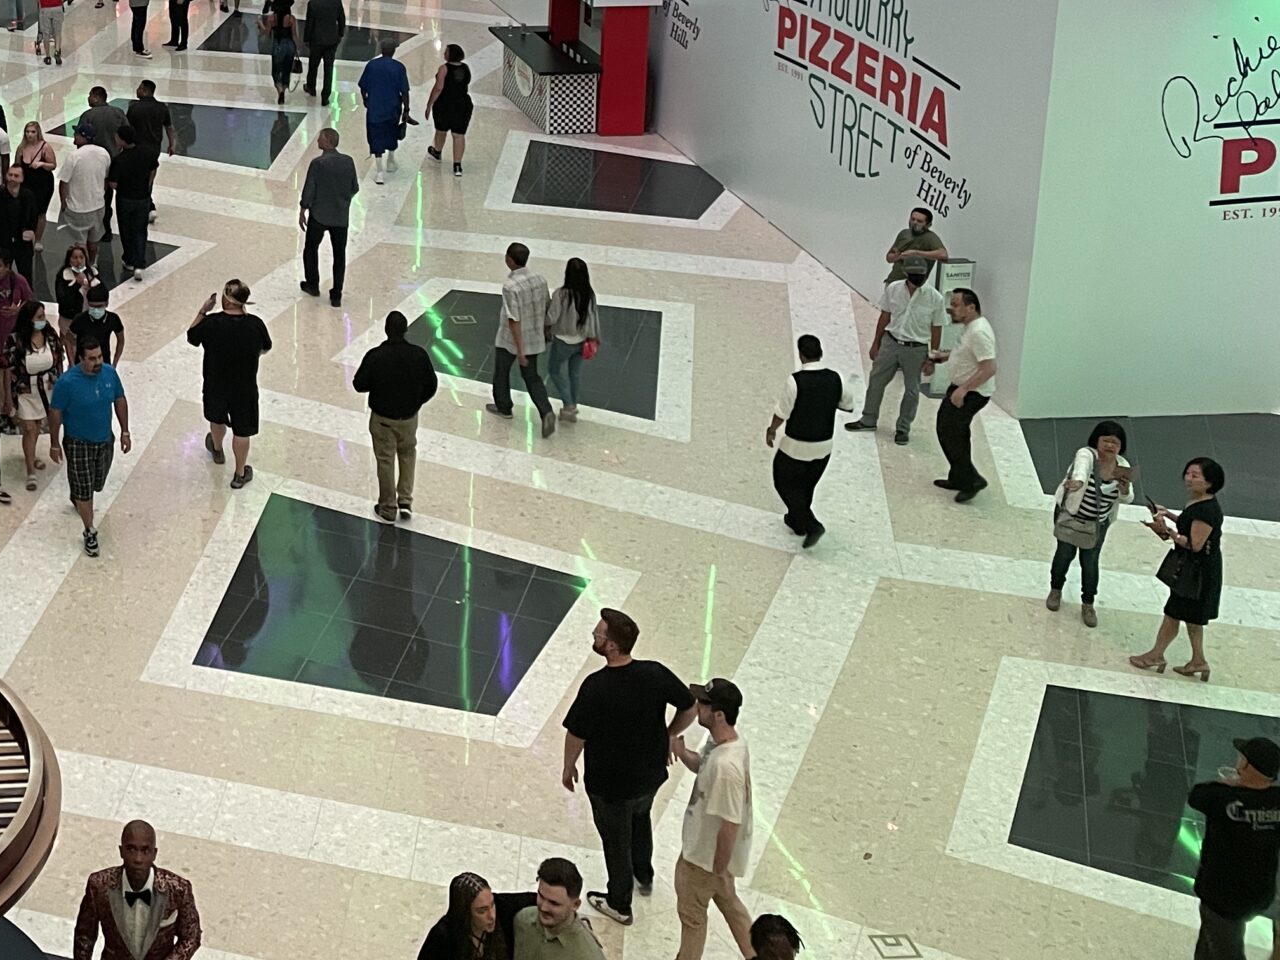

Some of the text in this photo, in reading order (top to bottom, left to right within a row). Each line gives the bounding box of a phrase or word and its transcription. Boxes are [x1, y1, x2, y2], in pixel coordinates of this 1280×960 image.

[670, 22, 689, 50] Hills
[672, 1, 701, 40] Beverly
[777, 5, 949, 148] PIZZERIA
[808, 72, 905, 178] STREET
[904, 145, 972, 209] of Beverly
[917, 178, 950, 219] Hills
[1222, 208, 1254, 221] EST.
